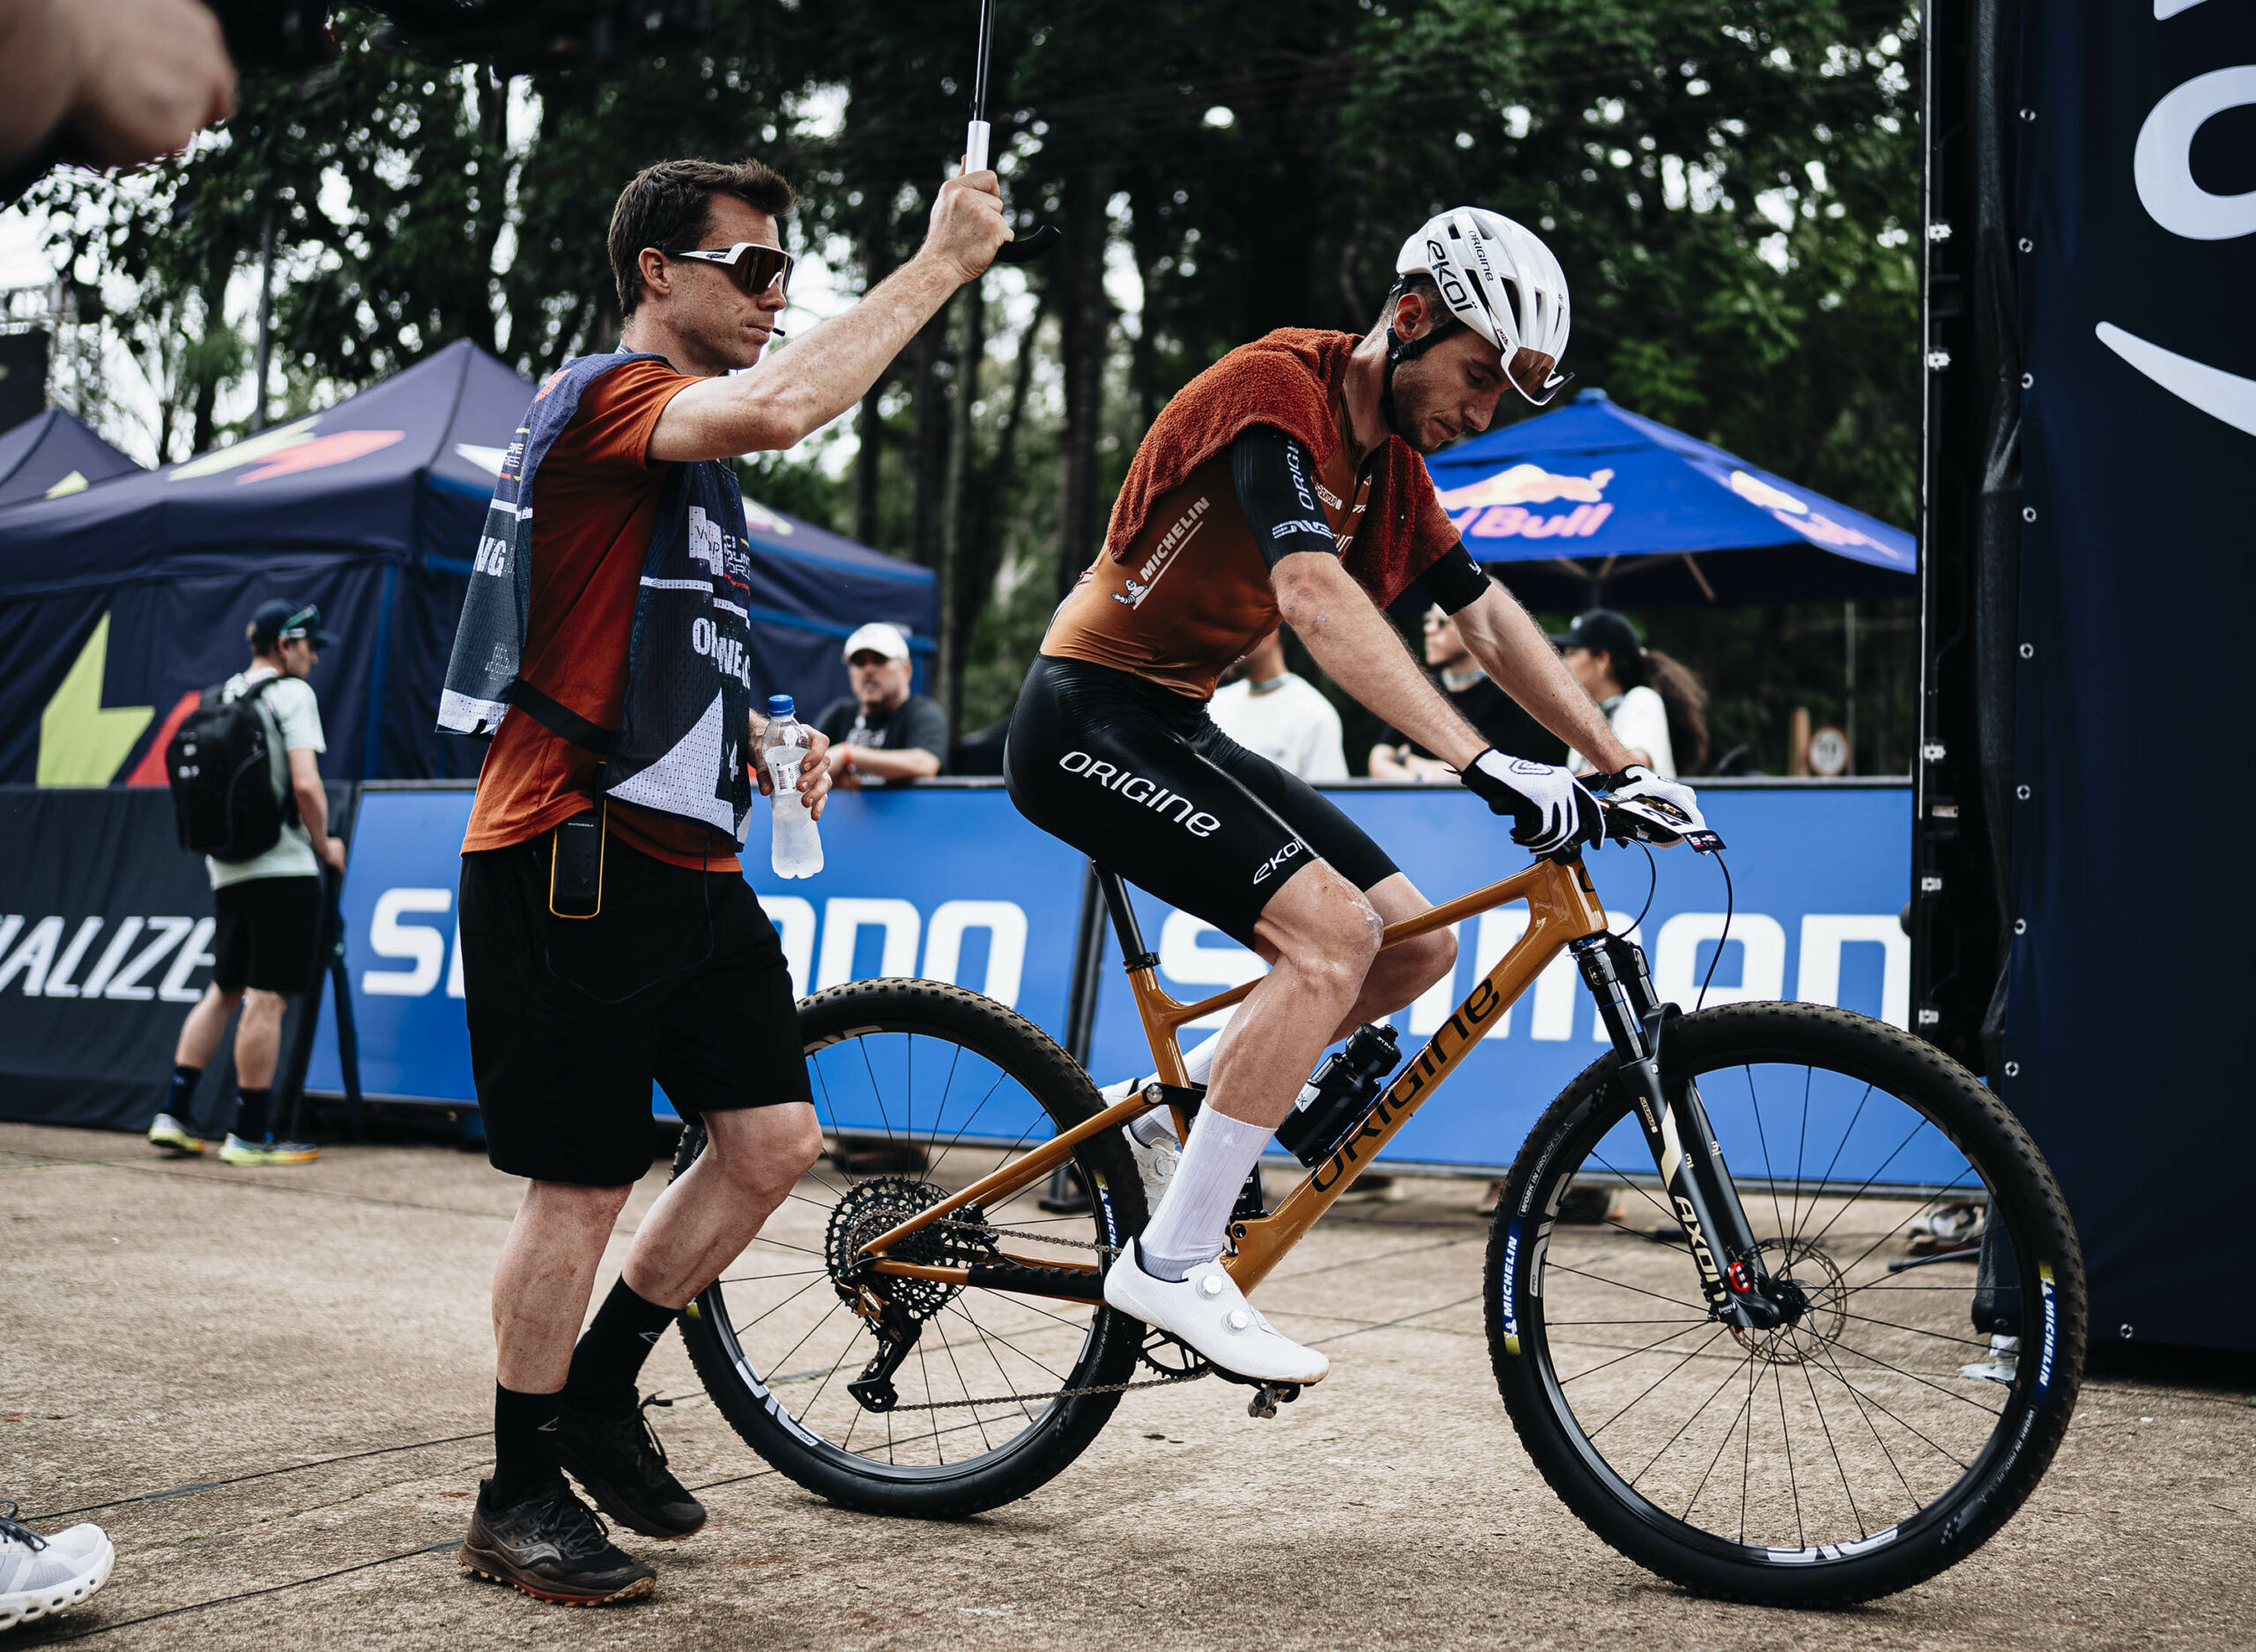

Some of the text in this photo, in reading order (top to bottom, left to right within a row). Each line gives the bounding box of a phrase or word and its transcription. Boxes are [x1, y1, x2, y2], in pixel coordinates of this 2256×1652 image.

[1287, 443, 1316, 511] ORIGI
[1139, 496, 1211, 582] MICHELIN
[1470, 502, 1614, 538] Bull
[1520, 1185, 1534, 1213] WORK
[1532, 1174, 1539, 1185] IN
[1503, 1235, 1518, 1317] MICHELIN
[2039, 1299, 2054, 1387] MICHELIN
